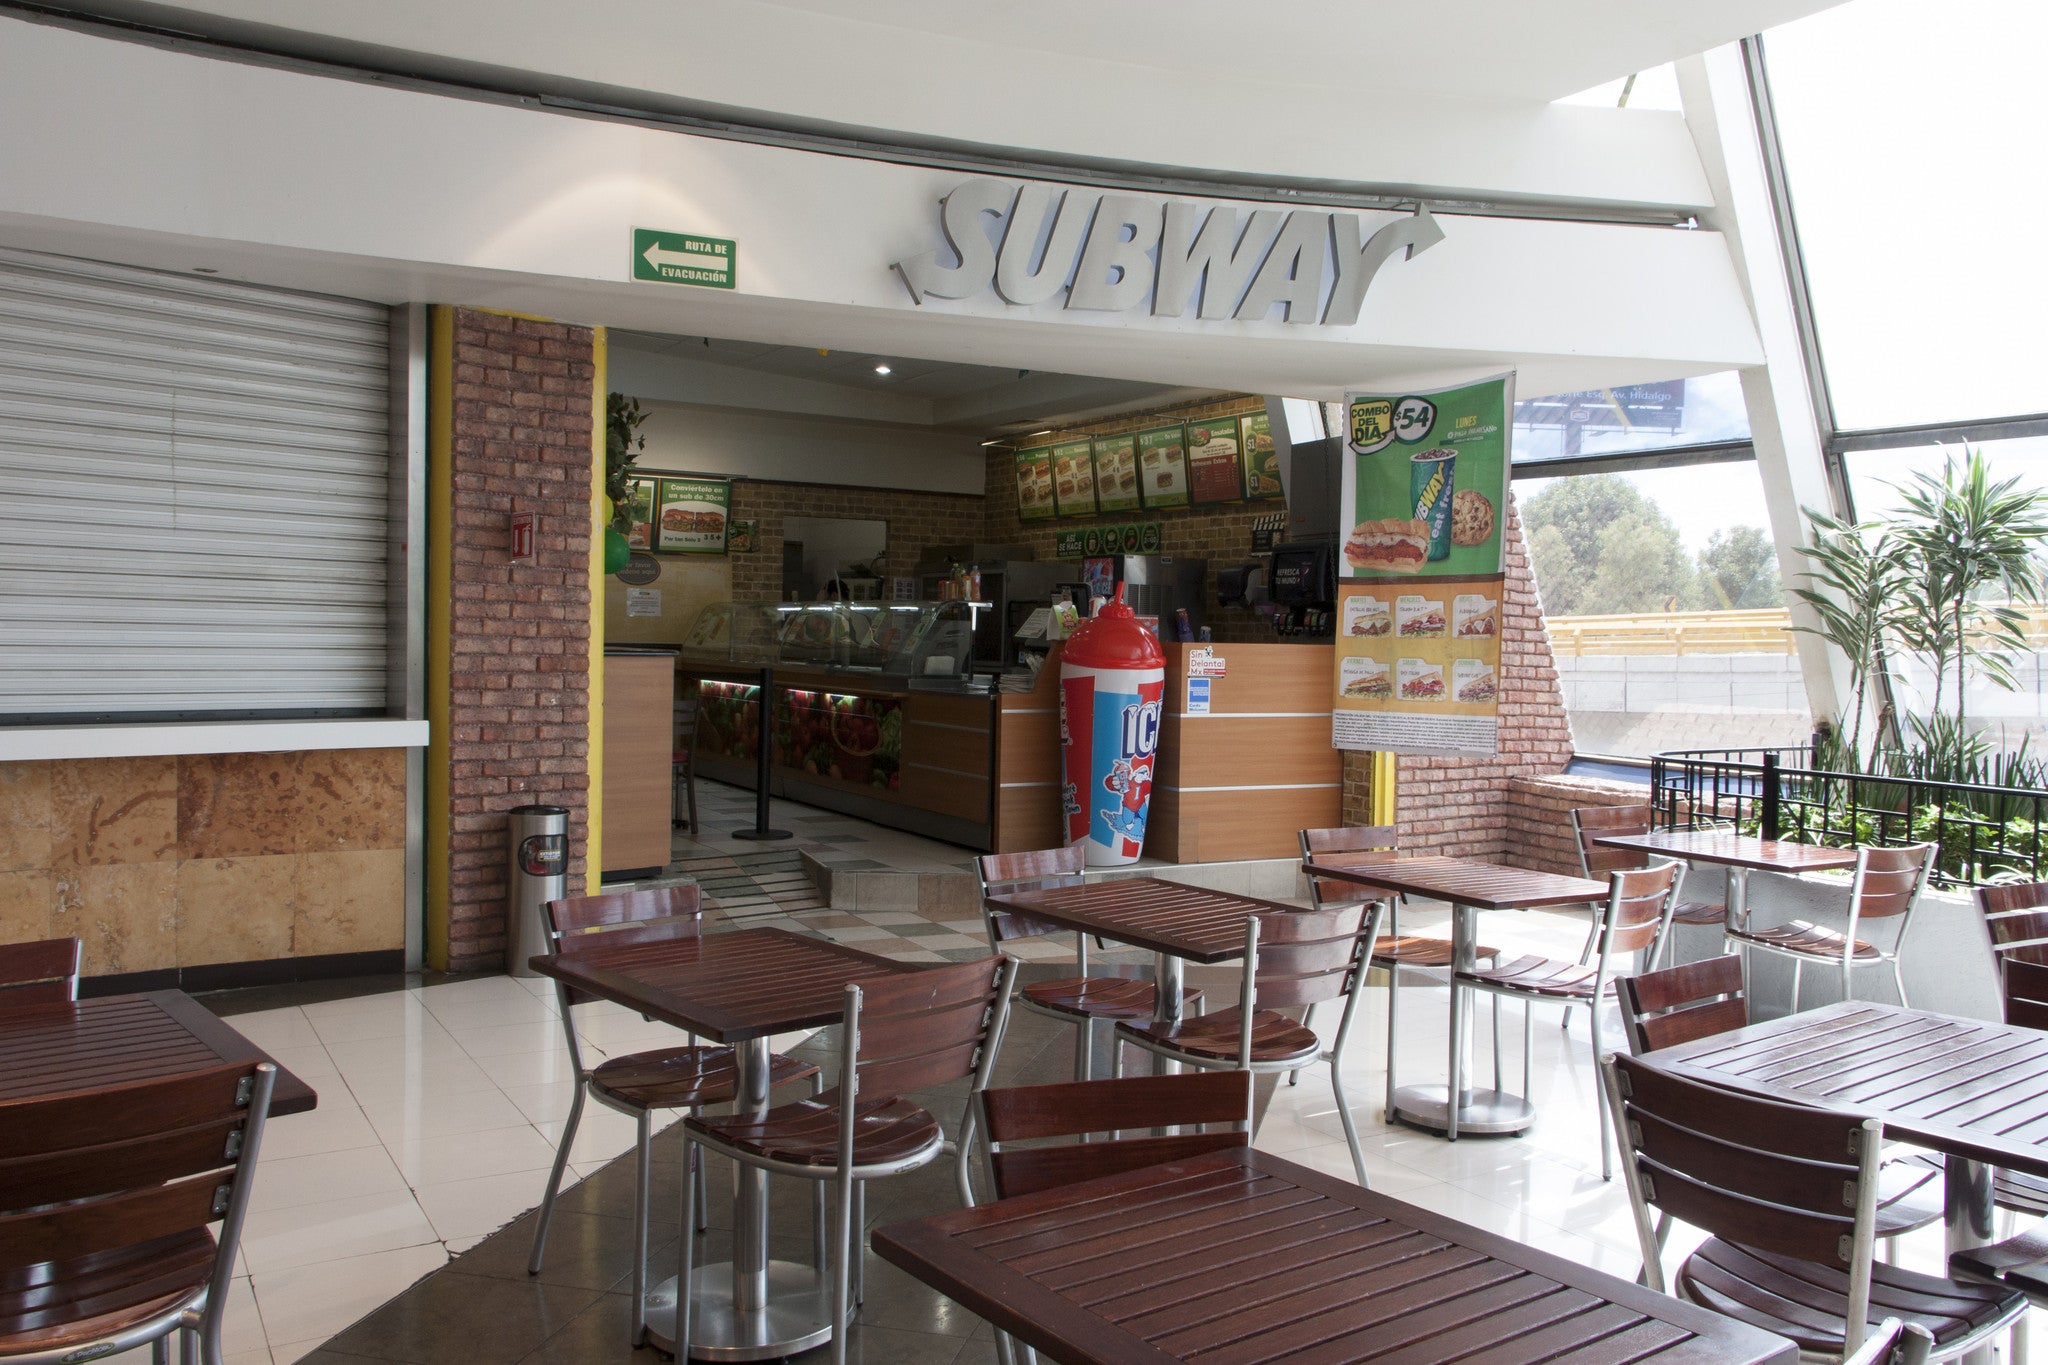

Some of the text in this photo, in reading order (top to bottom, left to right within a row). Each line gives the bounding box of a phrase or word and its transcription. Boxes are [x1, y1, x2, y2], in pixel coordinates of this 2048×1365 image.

[685, 240, 727, 254] RUTA DE
[889, 177, 1446, 326] SUBWAY
[661, 267, 727, 283] EVACUACIÓN
[1630, 391, 1672, 402] Hidalgo
[1351, 405, 1390, 419] COMBO
[1395, 406, 1430, 430] $54
[1358, 417, 1379, 426] DEL
[1455, 415, 1478, 429] LUNES
[671, 483, 712, 494] Conviértelo
[1412, 461, 1445, 520] UBWAY
[705, 494, 724, 502] 30cm
[1431, 512, 1445, 539] eat
[1058, 541, 1083, 552] SE HACE
[1190, 650, 1203, 659] Sin
[1190, 659, 1225, 668] Delantal
[1121, 699, 1163, 758] IC
